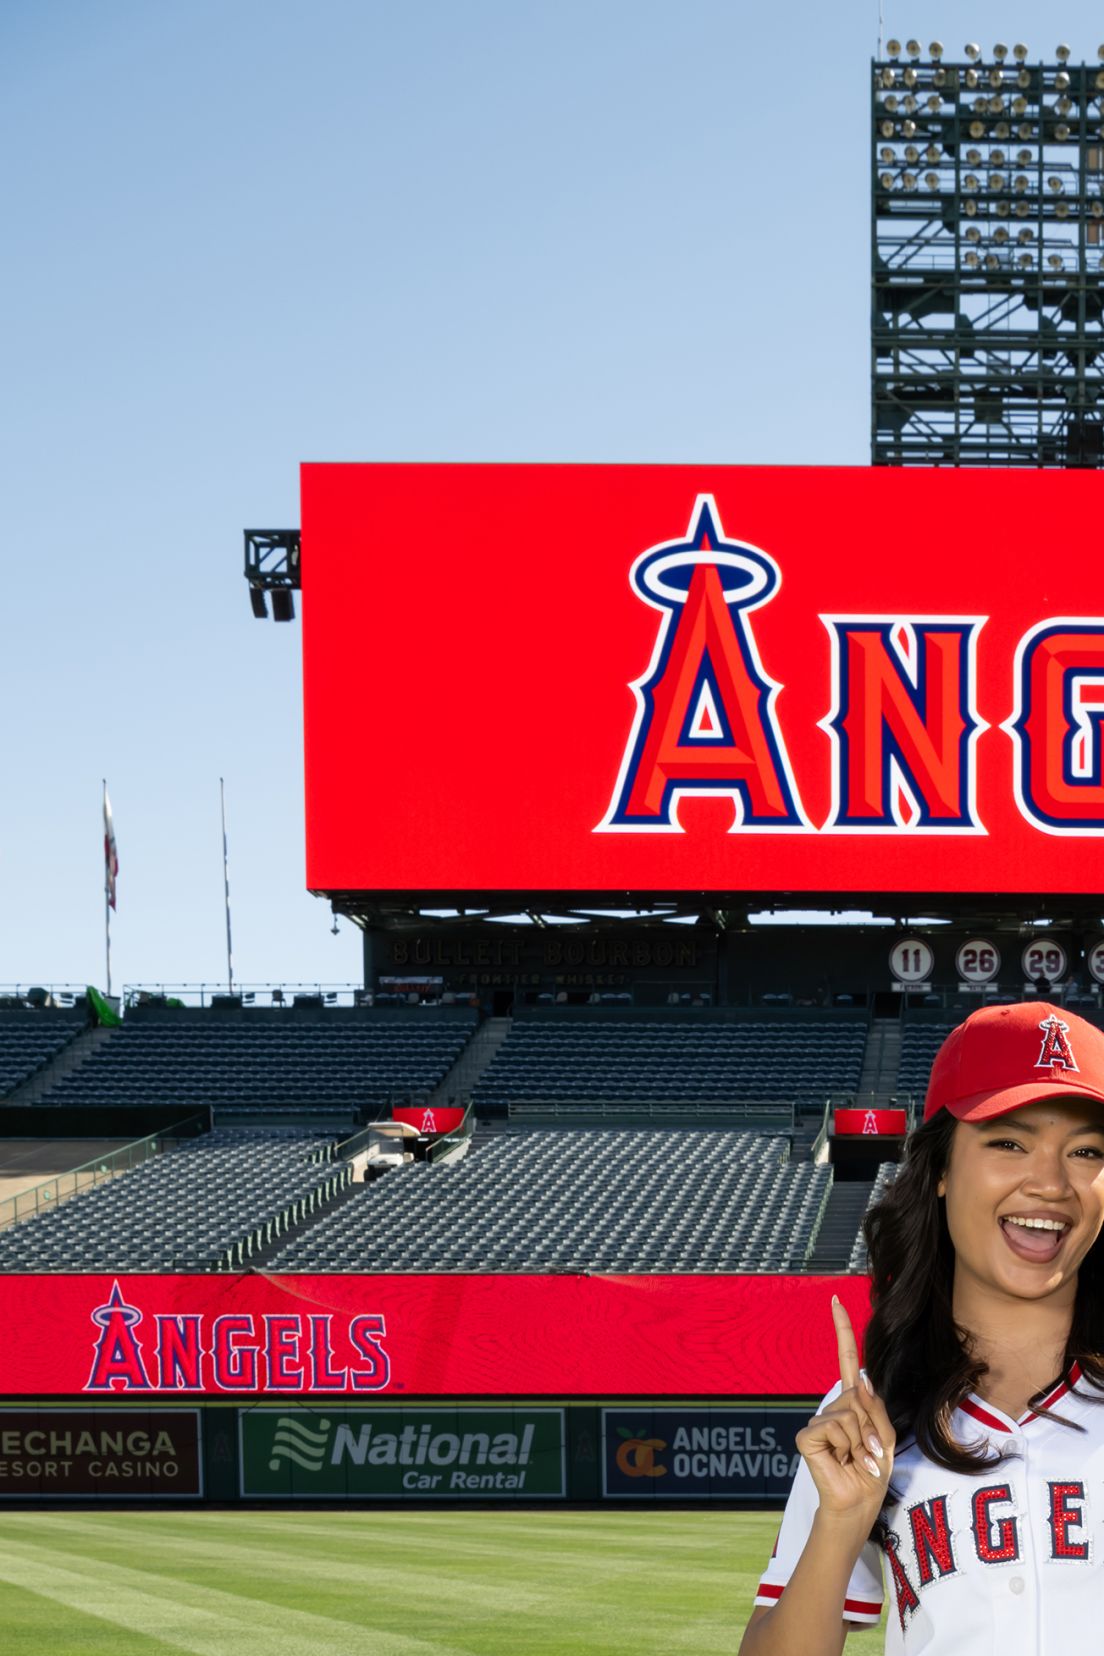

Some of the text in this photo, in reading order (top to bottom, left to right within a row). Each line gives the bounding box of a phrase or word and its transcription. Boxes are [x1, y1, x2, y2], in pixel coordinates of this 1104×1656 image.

[393, 939, 697, 966] BULLEIT BOURBON
[901, 949, 922, 973] 11
[963, 949, 994, 973] 26
[1030, 950, 1061, 974] 29
[1034, 1014, 1079, 1072] A
[421, 1108, 436, 1132] A
[862, 1110, 878, 1134] A
[83, 1279, 391, 1391] ANGELS
[331, 1423, 535, 1465] National
[673, 1427, 782, 1451] ANGELS.
[88, 1461, 179, 1477] CASINO
[402, 1471, 526, 1489] Car Rental
